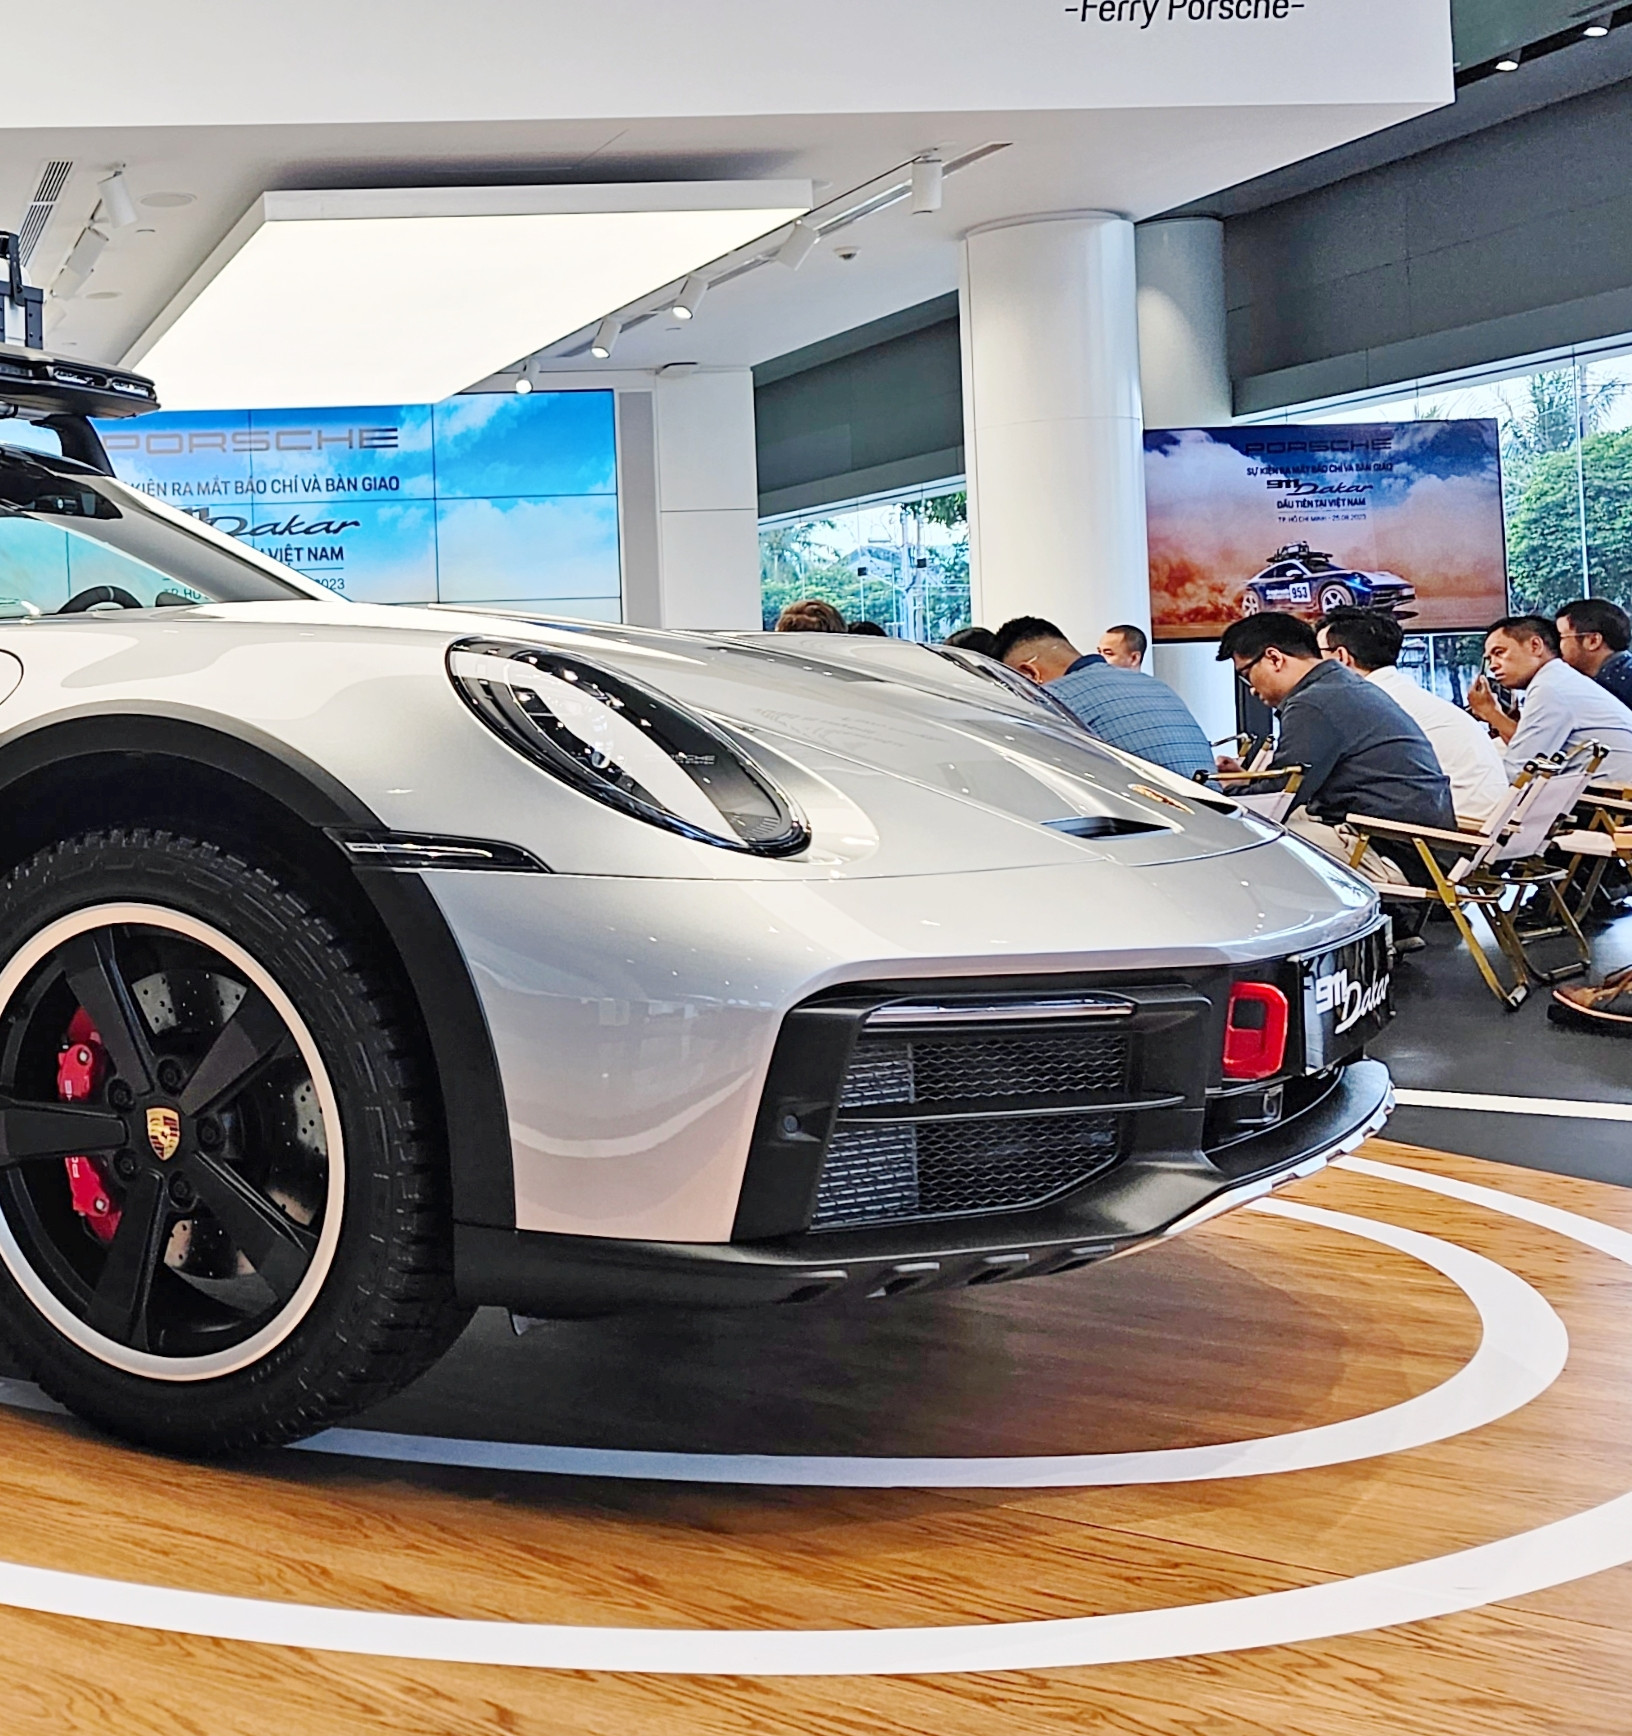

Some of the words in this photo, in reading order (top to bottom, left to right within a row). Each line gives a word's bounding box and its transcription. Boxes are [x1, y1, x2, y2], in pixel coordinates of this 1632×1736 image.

[103, 427, 399, 454] PORSCHE
[1245, 437, 1392, 454] PORSCHE
[172, 481, 194, 497] RA
[234, 475, 267, 495] BÁO
[271, 474, 298, 493] CHÍ
[303, 474, 322, 493] VÀ
[325, 474, 357, 493] BÀN
[361, 475, 400, 491] GIAO
[1267, 479, 1300, 489] 911
[1286, 481, 1373, 496] Dakar
[1348, 497, 1366, 506] NAM
[206, 513, 361, 537] Dakar
[267, 543, 304, 566] VIỆT
[307, 546, 344, 562] NAM
[1292, 586, 1308, 599] 953
[1315, 969, 1348, 1015] 911
[1334, 969, 1390, 1034] Dakar
